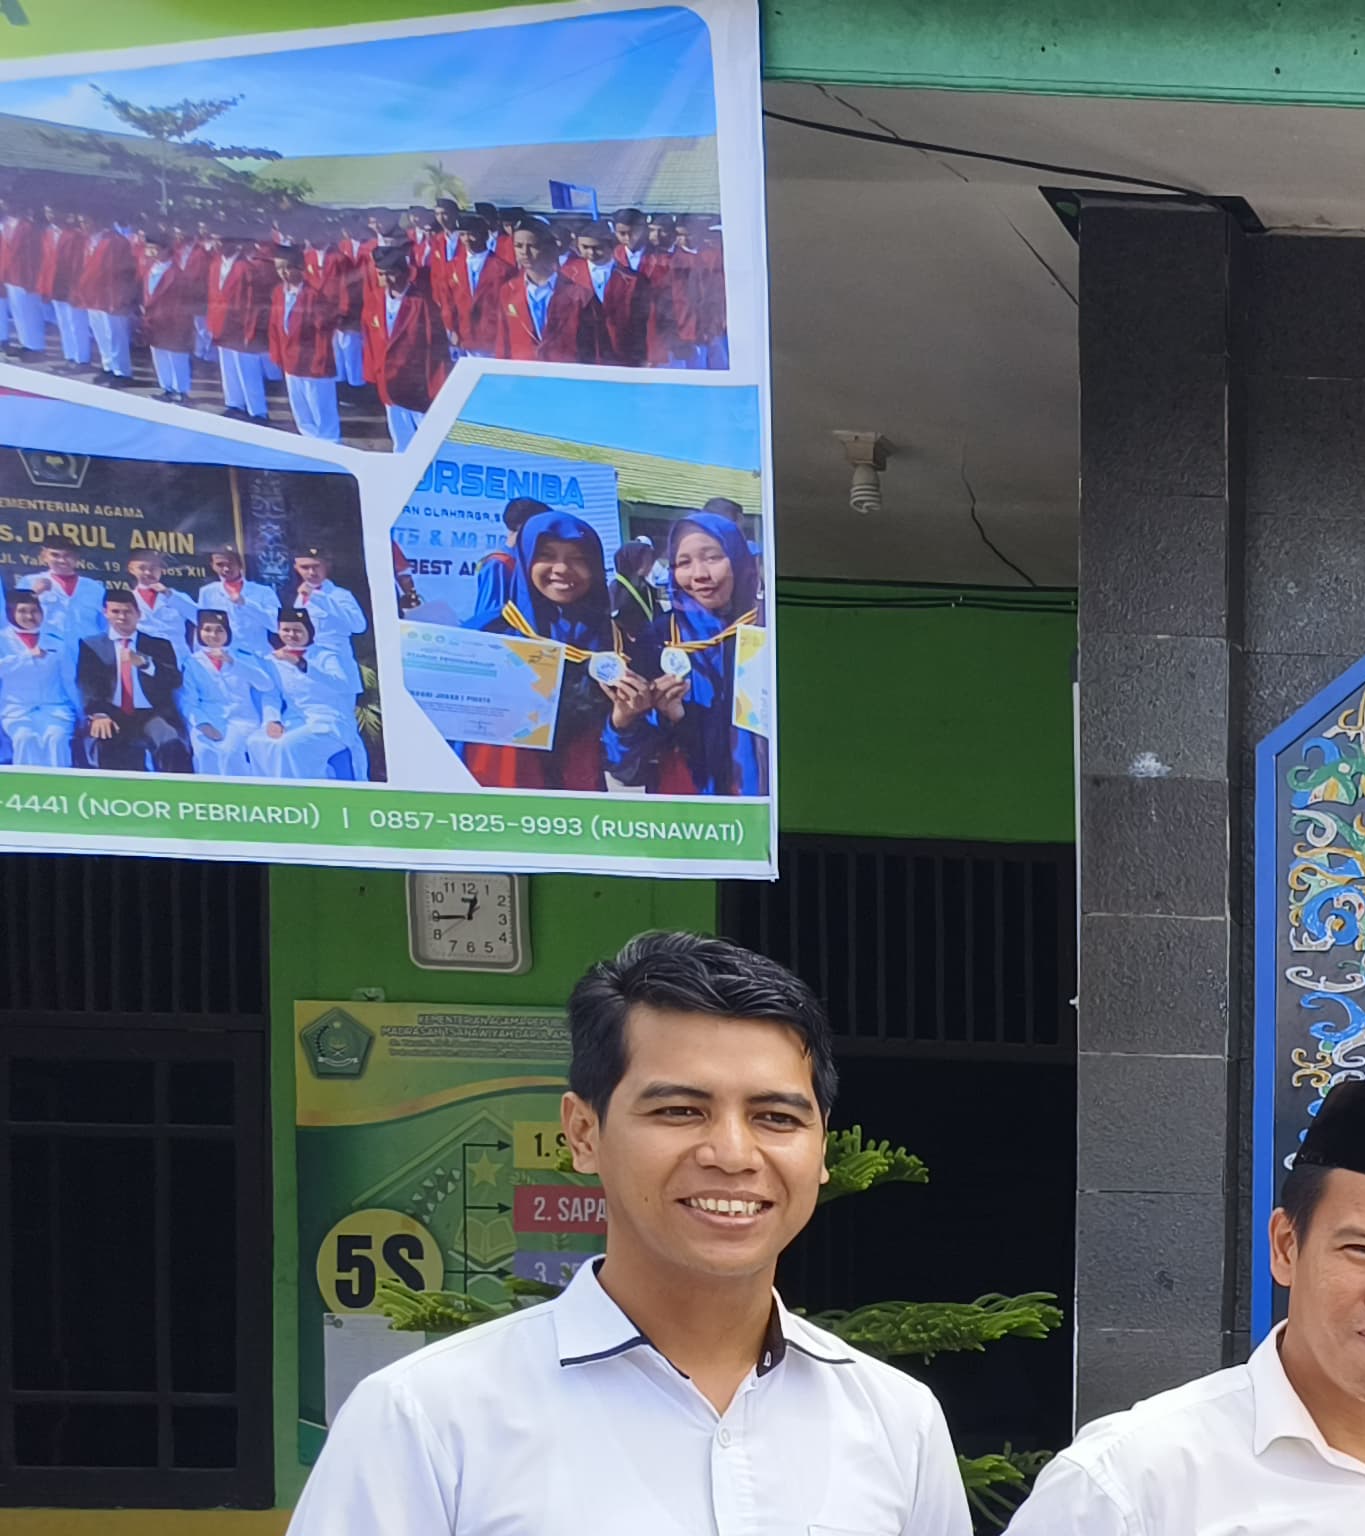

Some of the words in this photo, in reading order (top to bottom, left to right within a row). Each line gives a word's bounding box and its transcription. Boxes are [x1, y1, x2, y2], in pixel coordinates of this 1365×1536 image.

[130, 529, 194, 555] AMIN
[78, 791, 171, 820] (NOOR
[179, 802, 320, 829] PEBRIARDI)
[369, 809, 583, 836] 0857-1825-9993
[591, 814, 744, 846] (RUSNAWATI)
[461, 882, 476, 895] 12
[431, 891, 444, 904] 10
[497, 895, 506, 907] 2
[498, 913, 507, 926] 3
[433, 928, 442, 940] 8
[498, 931, 507, 943] 4
[449, 940, 458, 952] 7
[466, 941, 476, 953] 6
[484, 941, 494, 953] 5
[534, 1132, 550, 1157] 1.
[534, 1196, 551, 1222] 2.
[558, 1197, 607, 1222] SAPA
[335, 1233, 425, 1309] 5S
